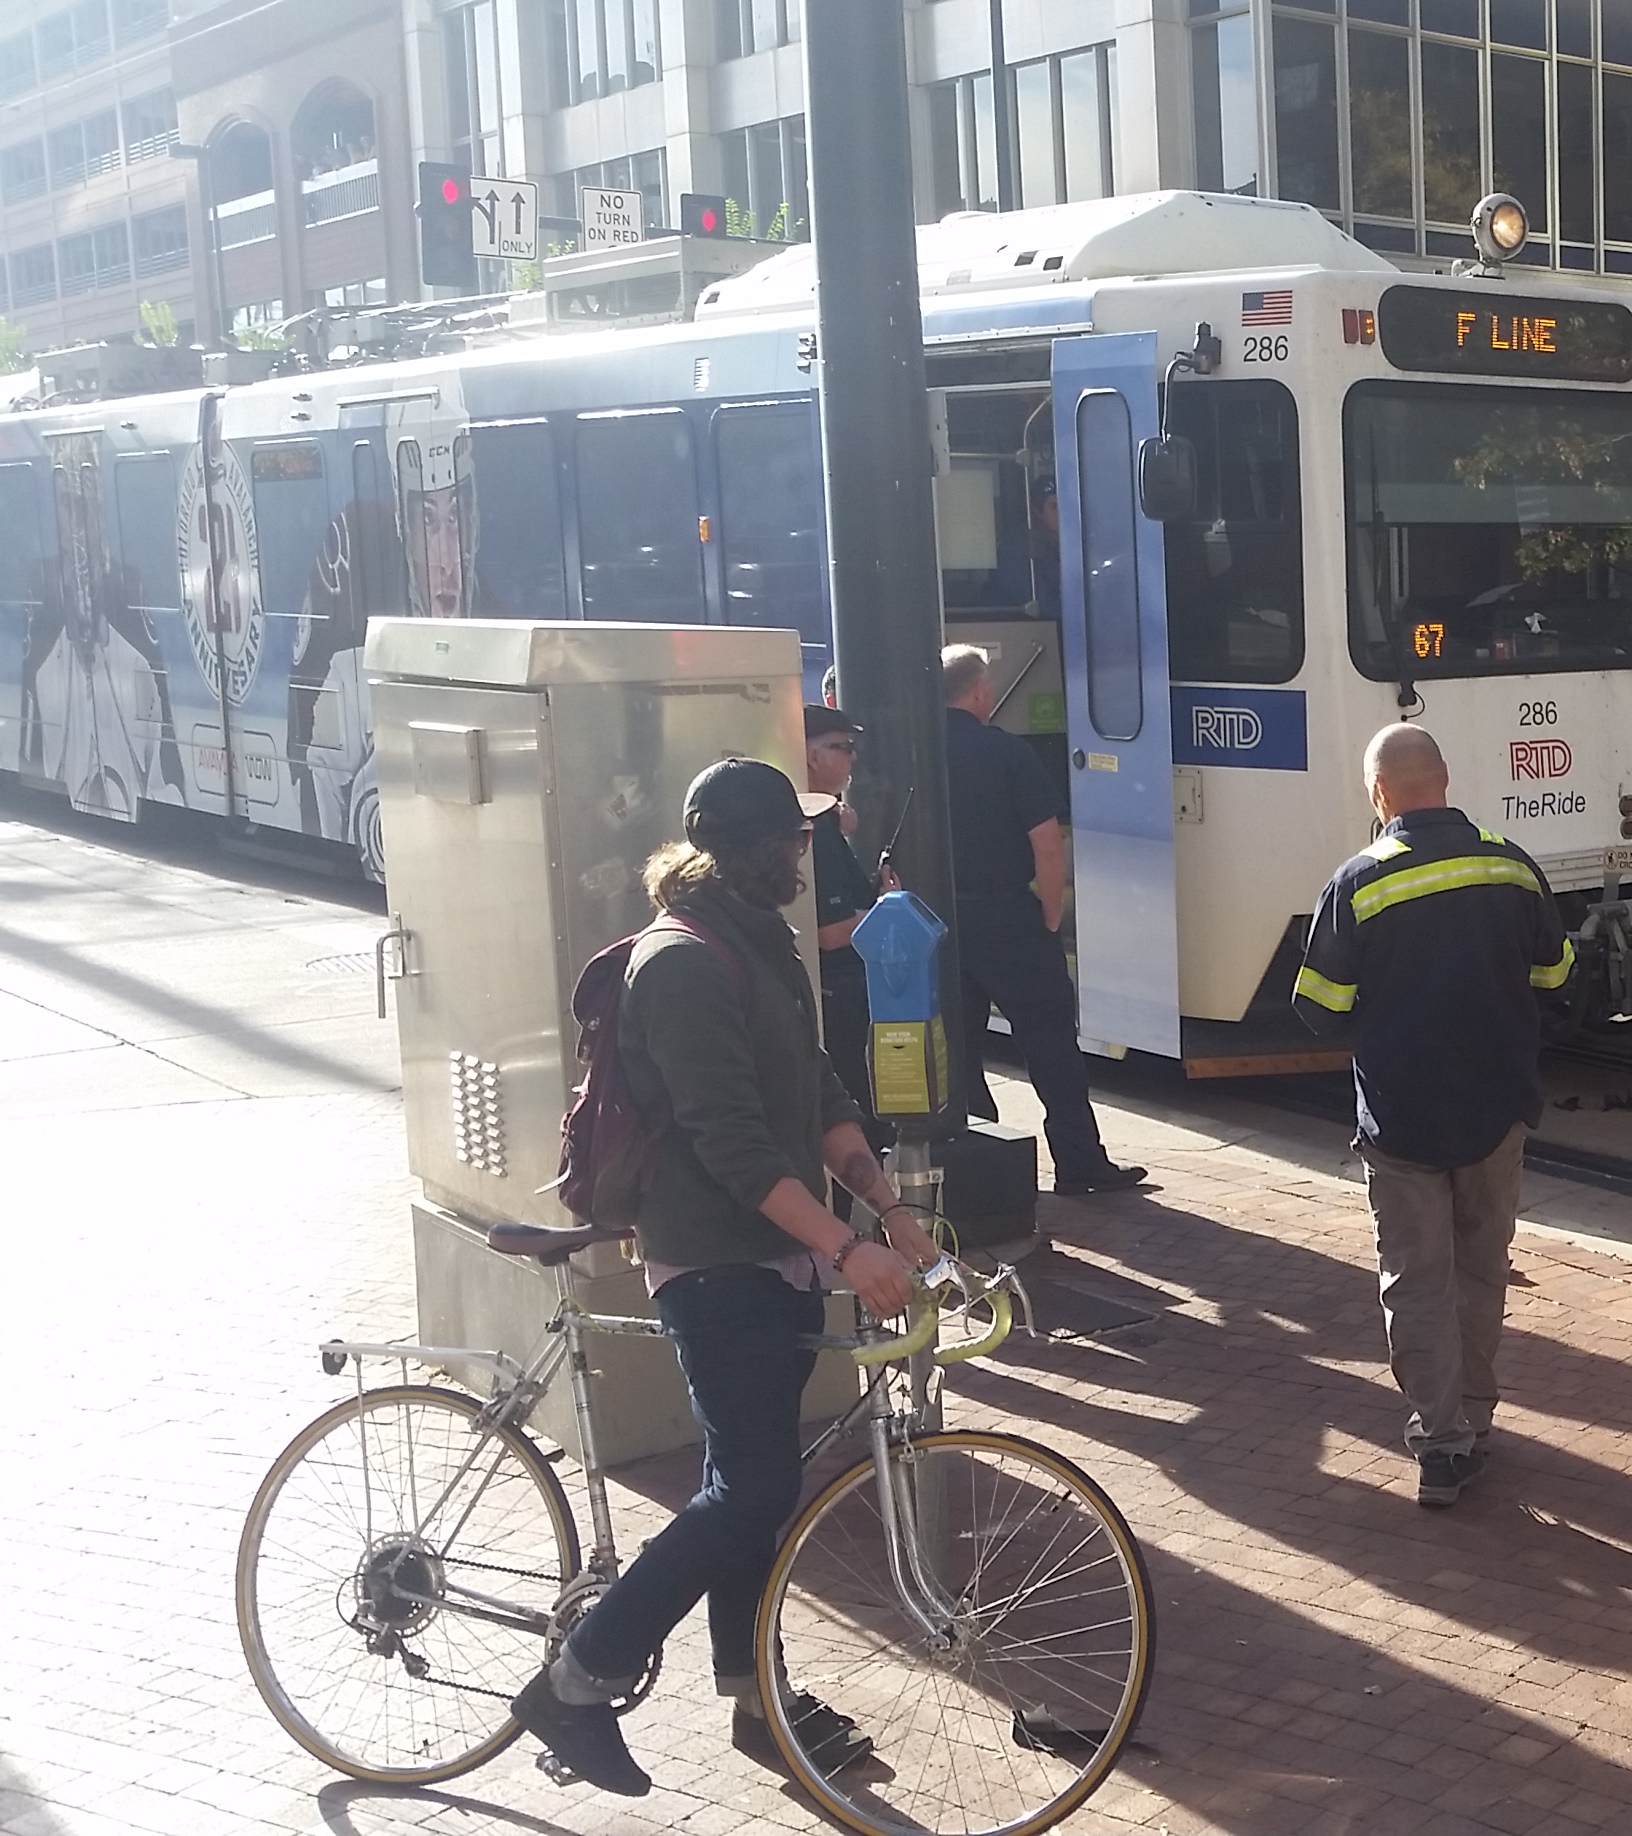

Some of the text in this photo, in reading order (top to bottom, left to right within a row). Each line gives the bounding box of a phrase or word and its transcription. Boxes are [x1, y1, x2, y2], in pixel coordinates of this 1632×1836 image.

[600, 194, 624, 209] NO
[596, 211, 631, 226] TURN
[502, 240, 533, 254] ONLY
[588, 228, 639, 243] ON RED
[1456, 311, 1557, 353] F LINE
[1243, 335, 1289, 363] 286
[1414, 623, 1445, 658] 67
[1518, 701, 1558, 726] 286
[1192, 705, 1263, 750] RTD
[1509, 739, 1573, 781] RTD
[1502, 791, 1586, 820] TheRide
[1618, 852, 1628, 860] DO
